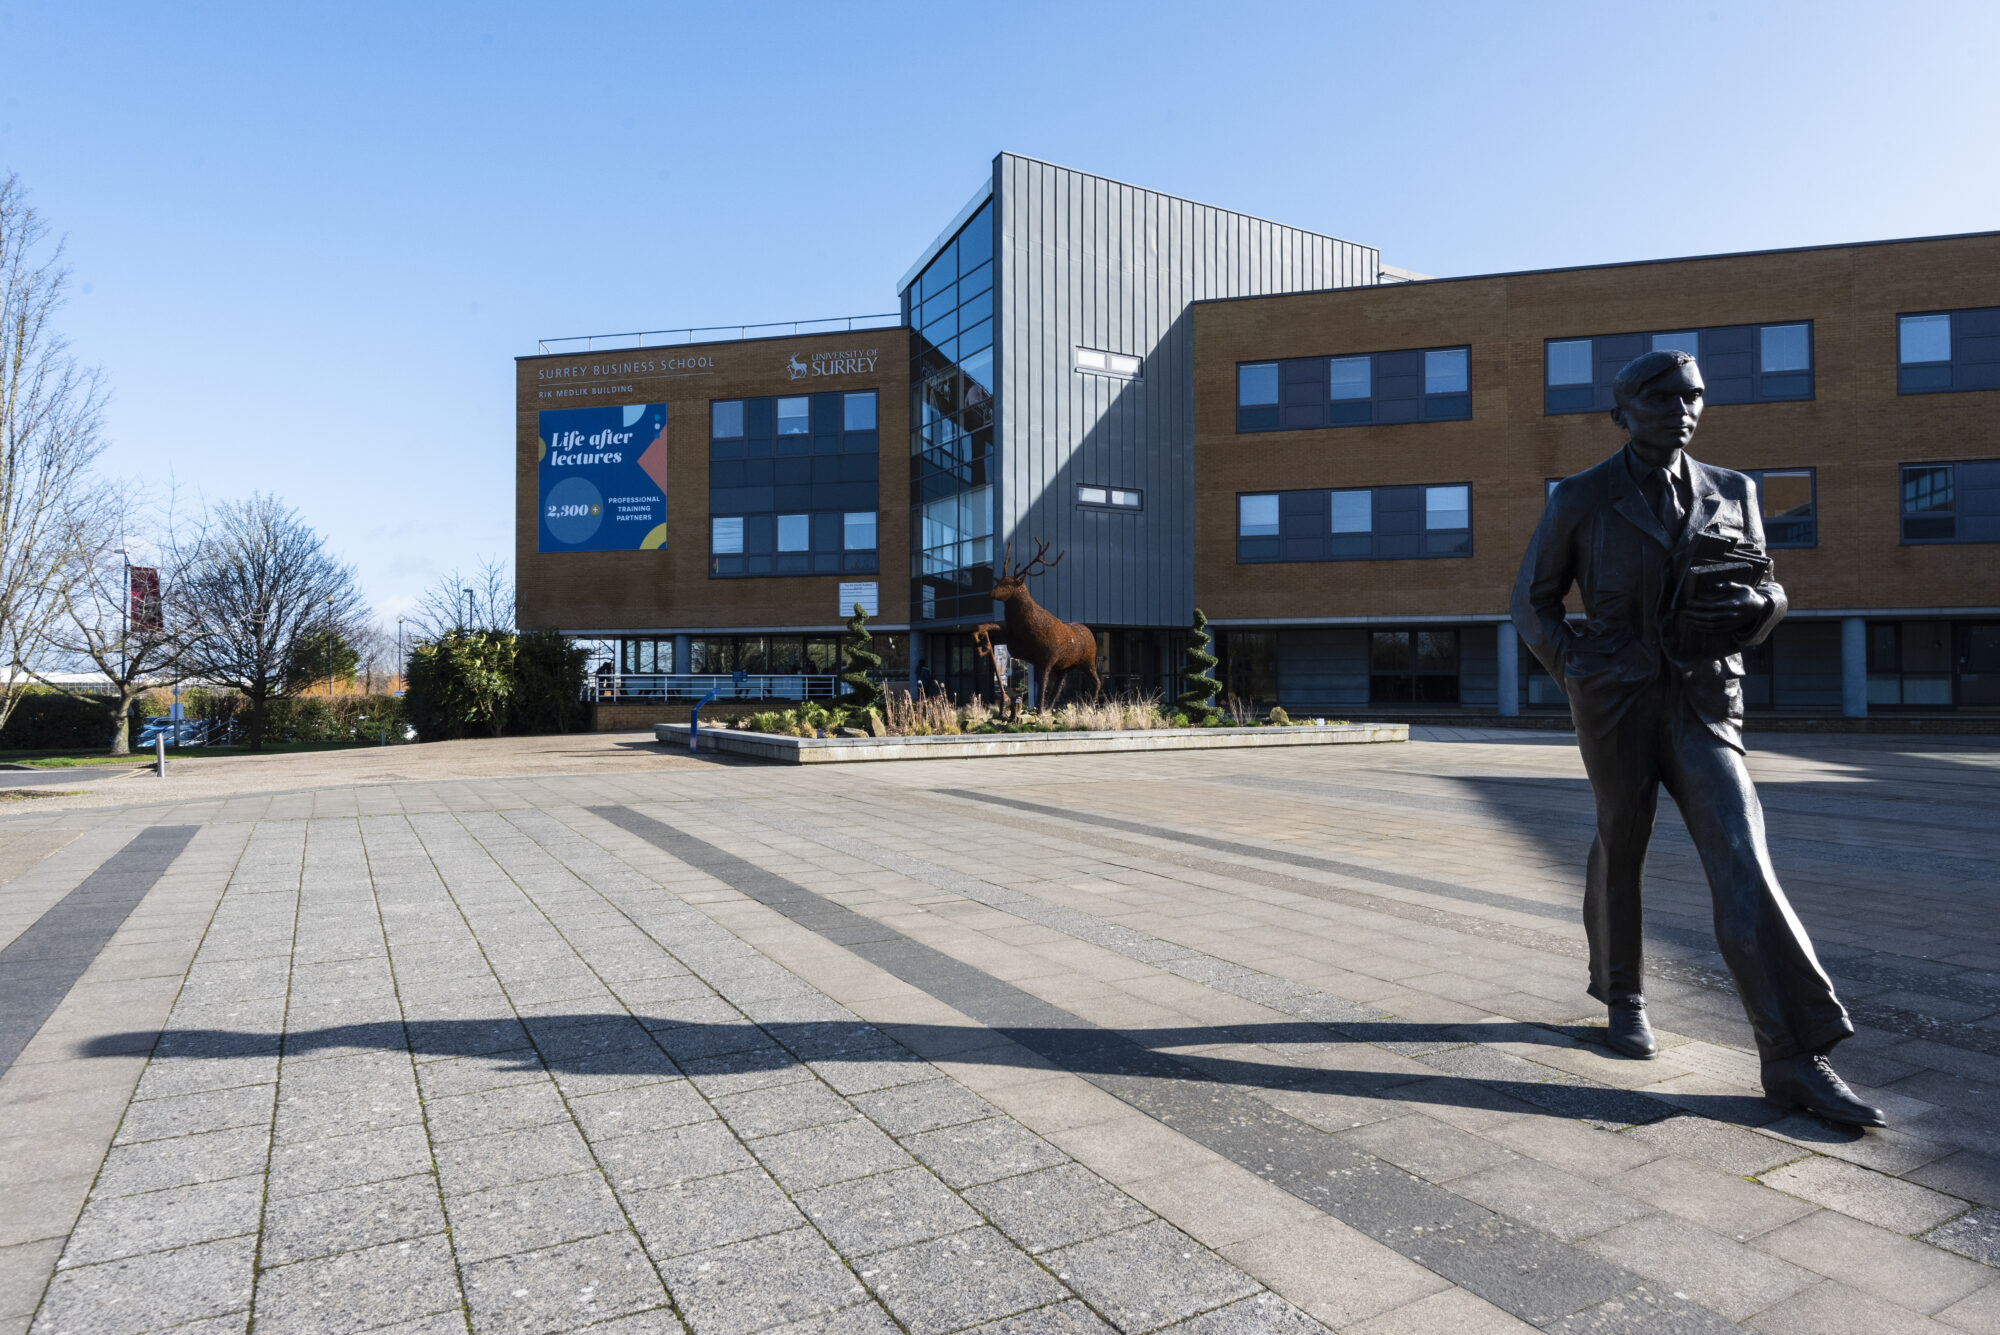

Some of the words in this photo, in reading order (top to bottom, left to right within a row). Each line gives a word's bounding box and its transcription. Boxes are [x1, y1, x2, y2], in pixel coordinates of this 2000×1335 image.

[811, 350, 865, 361] UNIVERSITY
[866, 348, 878, 357] OF
[538, 366, 587, 380] SURREY
[593, 360, 655, 376] BUSINESS
[660, 357, 715, 371] SCHOOL
[811, 357, 878, 377] SURREY
[556, 389, 588, 397] MEDLIK
[591, 385, 633, 394] BUILDING
[551, 430, 586, 452] Life
[589, 429, 633, 450] after
[551, 451, 622, 466] lectures
